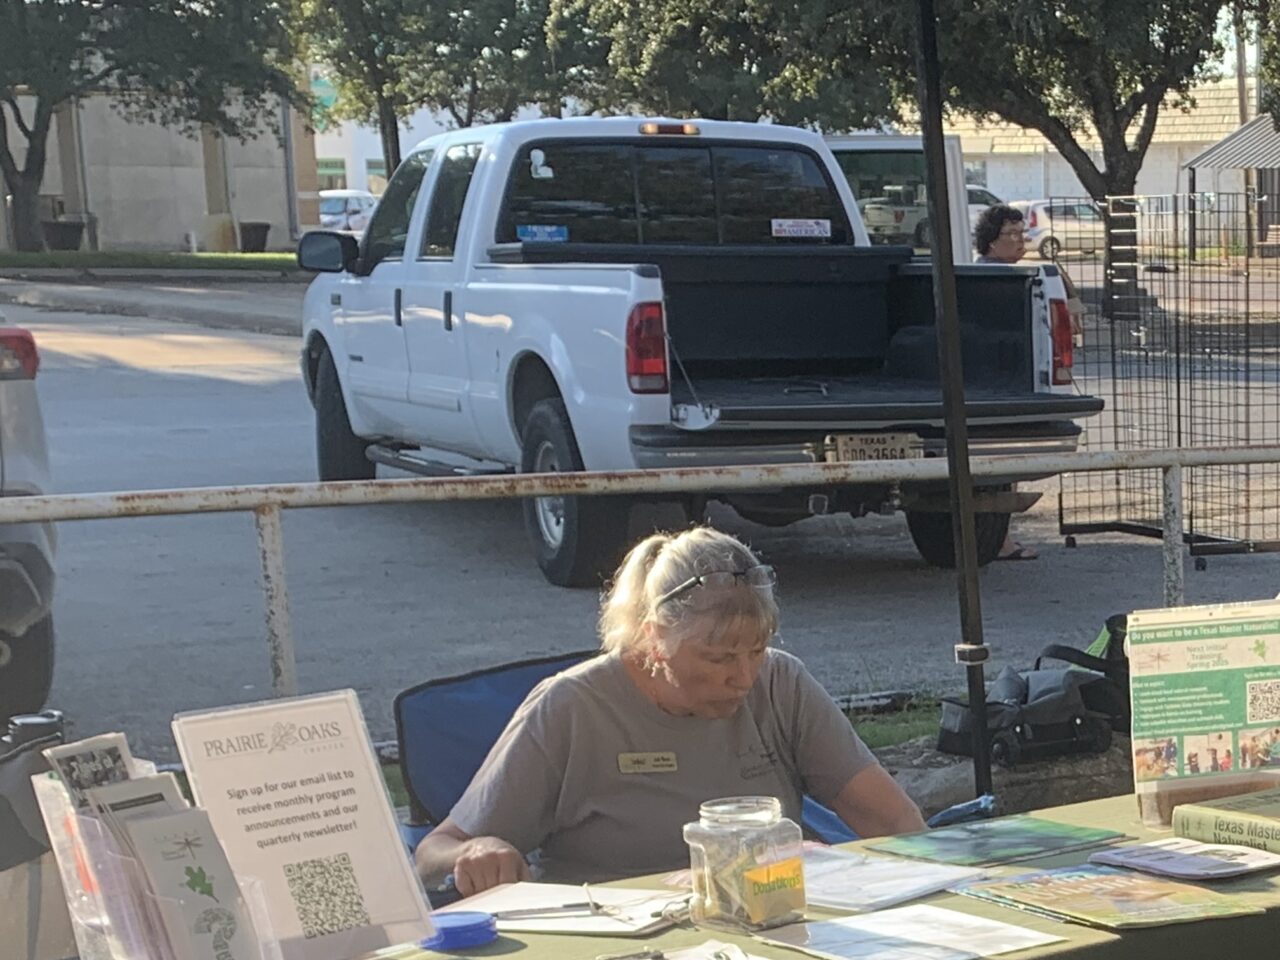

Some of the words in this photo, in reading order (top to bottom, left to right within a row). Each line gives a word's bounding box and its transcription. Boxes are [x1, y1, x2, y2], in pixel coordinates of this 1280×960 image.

[860, 437, 887, 446] TEXAS
[1142, 630, 1155, 642] you
[1156, 629, 1174, 639] want
[1174, 628, 1183, 638] to
[1184, 627, 1193, 637] be
[1199, 625, 1218, 636] Texas
[1219, 623, 1242, 635] Master
[203, 732, 268, 758] PRAIRIE
[298, 721, 342, 743] OAKS
[226, 788, 248, 800] Sign
[250, 786, 263, 796] up
[264, 783, 279, 792] for
[281, 781, 297, 791] our
[300, 773, 326, 786] email
[327, 771, 341, 782] list
[343, 769, 354, 779] to
[236, 802, 272, 815] receive
[274, 795, 314, 810] monthly
[315, 787, 356, 804] program
[244, 811, 321, 833] announcements
[323, 806, 341, 818] and
[343, 804, 358, 815] our
[1213, 816, 1244, 835] Texas
[256, 833, 301, 849] quarterly
[303, 820, 358, 839] newsletter!
[752, 873, 800, 896] Donations
